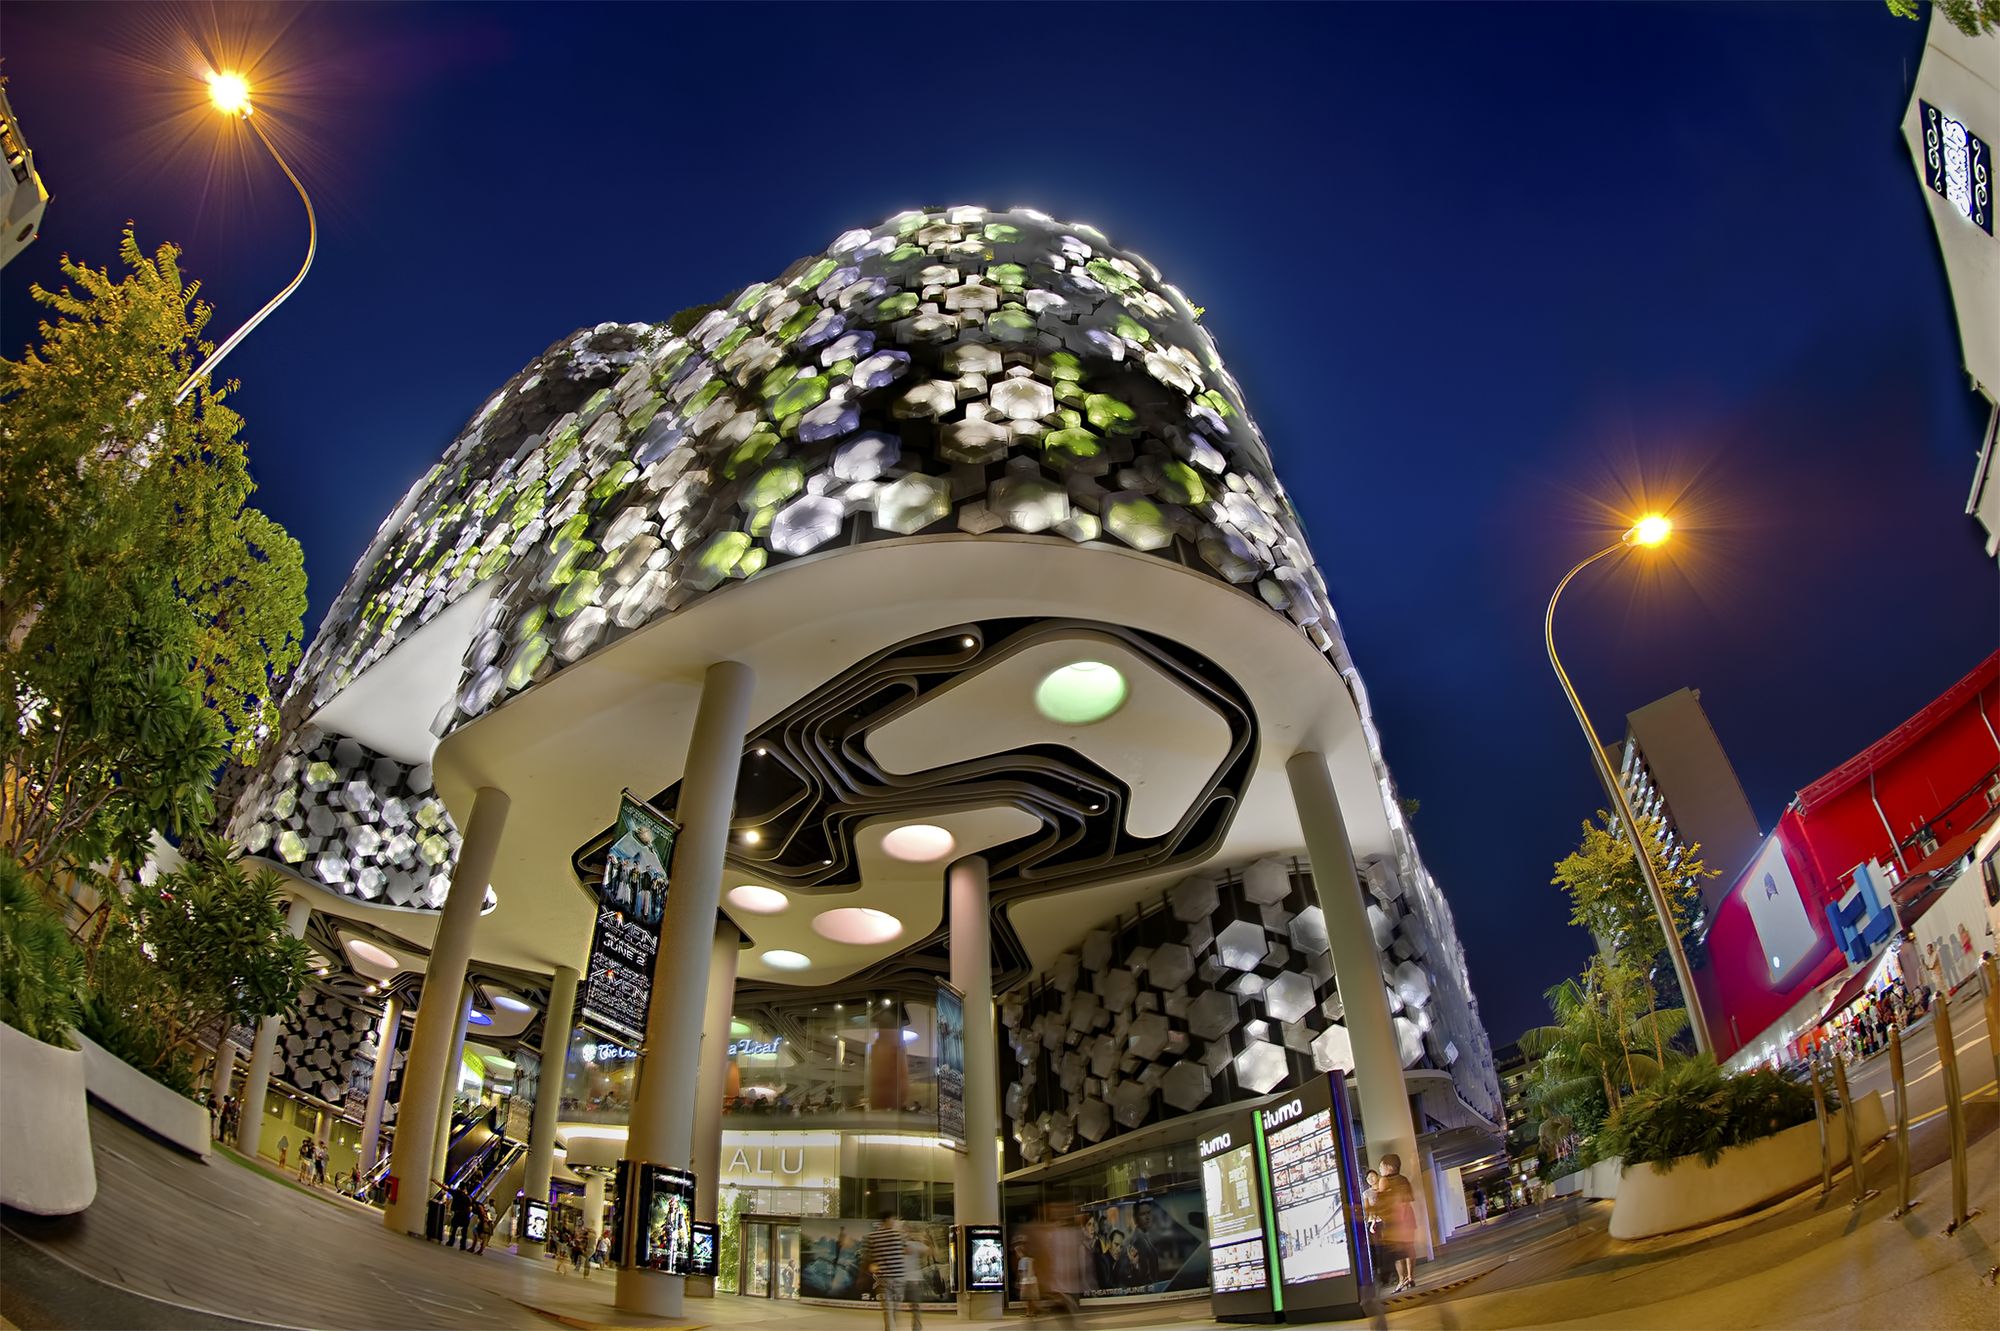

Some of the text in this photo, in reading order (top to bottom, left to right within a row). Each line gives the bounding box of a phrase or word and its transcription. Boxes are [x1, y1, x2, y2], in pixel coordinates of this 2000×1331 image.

[603, 940, 634, 960] JUNE
[636, 956, 646, 967] 2
[624, 933, 656, 955] CLASS
[598, 1044, 617, 1060] The
[738, 1036, 782, 1054] Leaf
[1262, 1099, 1303, 1130] iluma
[1200, 1132, 1232, 1157] iluma
[728, 1148, 804, 1174] ALU
